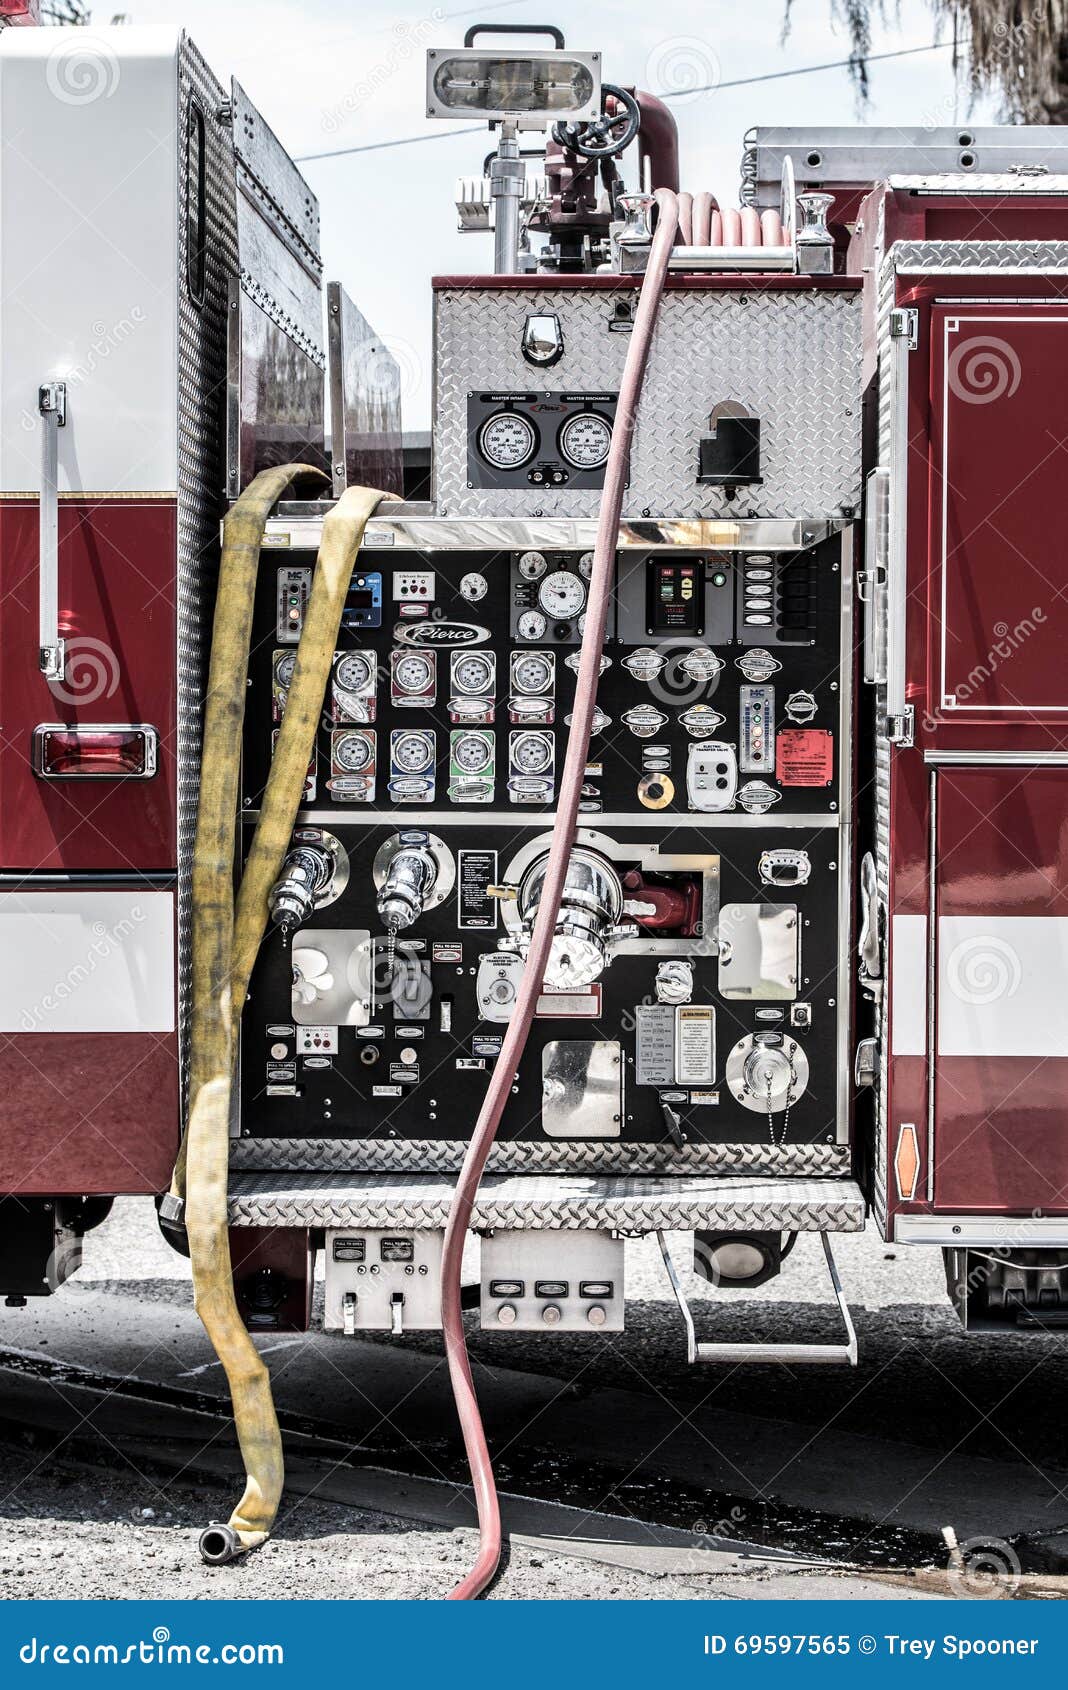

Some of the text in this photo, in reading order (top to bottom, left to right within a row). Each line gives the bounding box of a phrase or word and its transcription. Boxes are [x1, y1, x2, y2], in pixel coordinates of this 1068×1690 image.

[287, 571, 303, 579] MC
[412, 627, 475, 640] Pierce
[749, 688, 765, 698] MC
